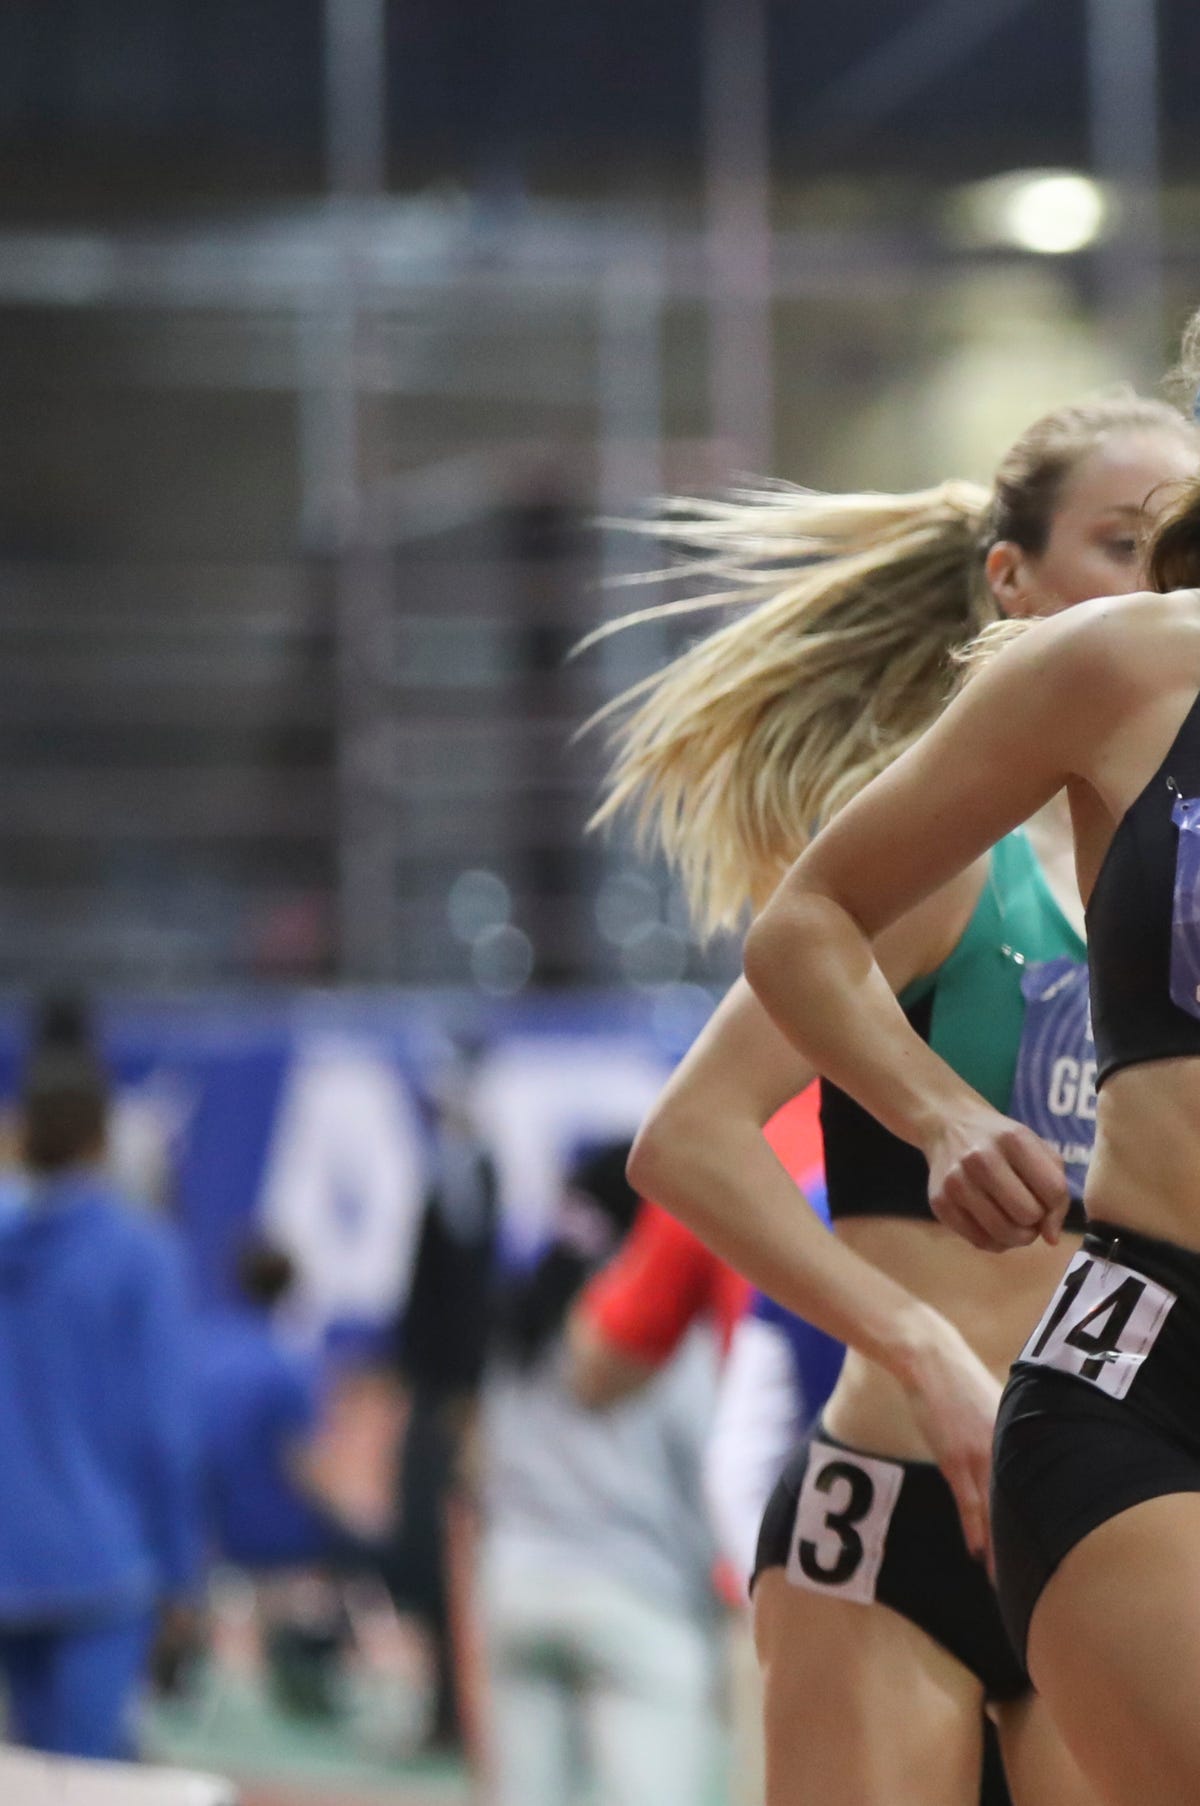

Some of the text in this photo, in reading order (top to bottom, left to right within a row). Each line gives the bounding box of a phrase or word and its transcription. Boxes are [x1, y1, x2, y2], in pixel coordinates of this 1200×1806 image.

[1047, 1056, 1097, 1120] GE
[1031, 1259, 1147, 1382] 14
[798, 1461, 875, 1586] 3
